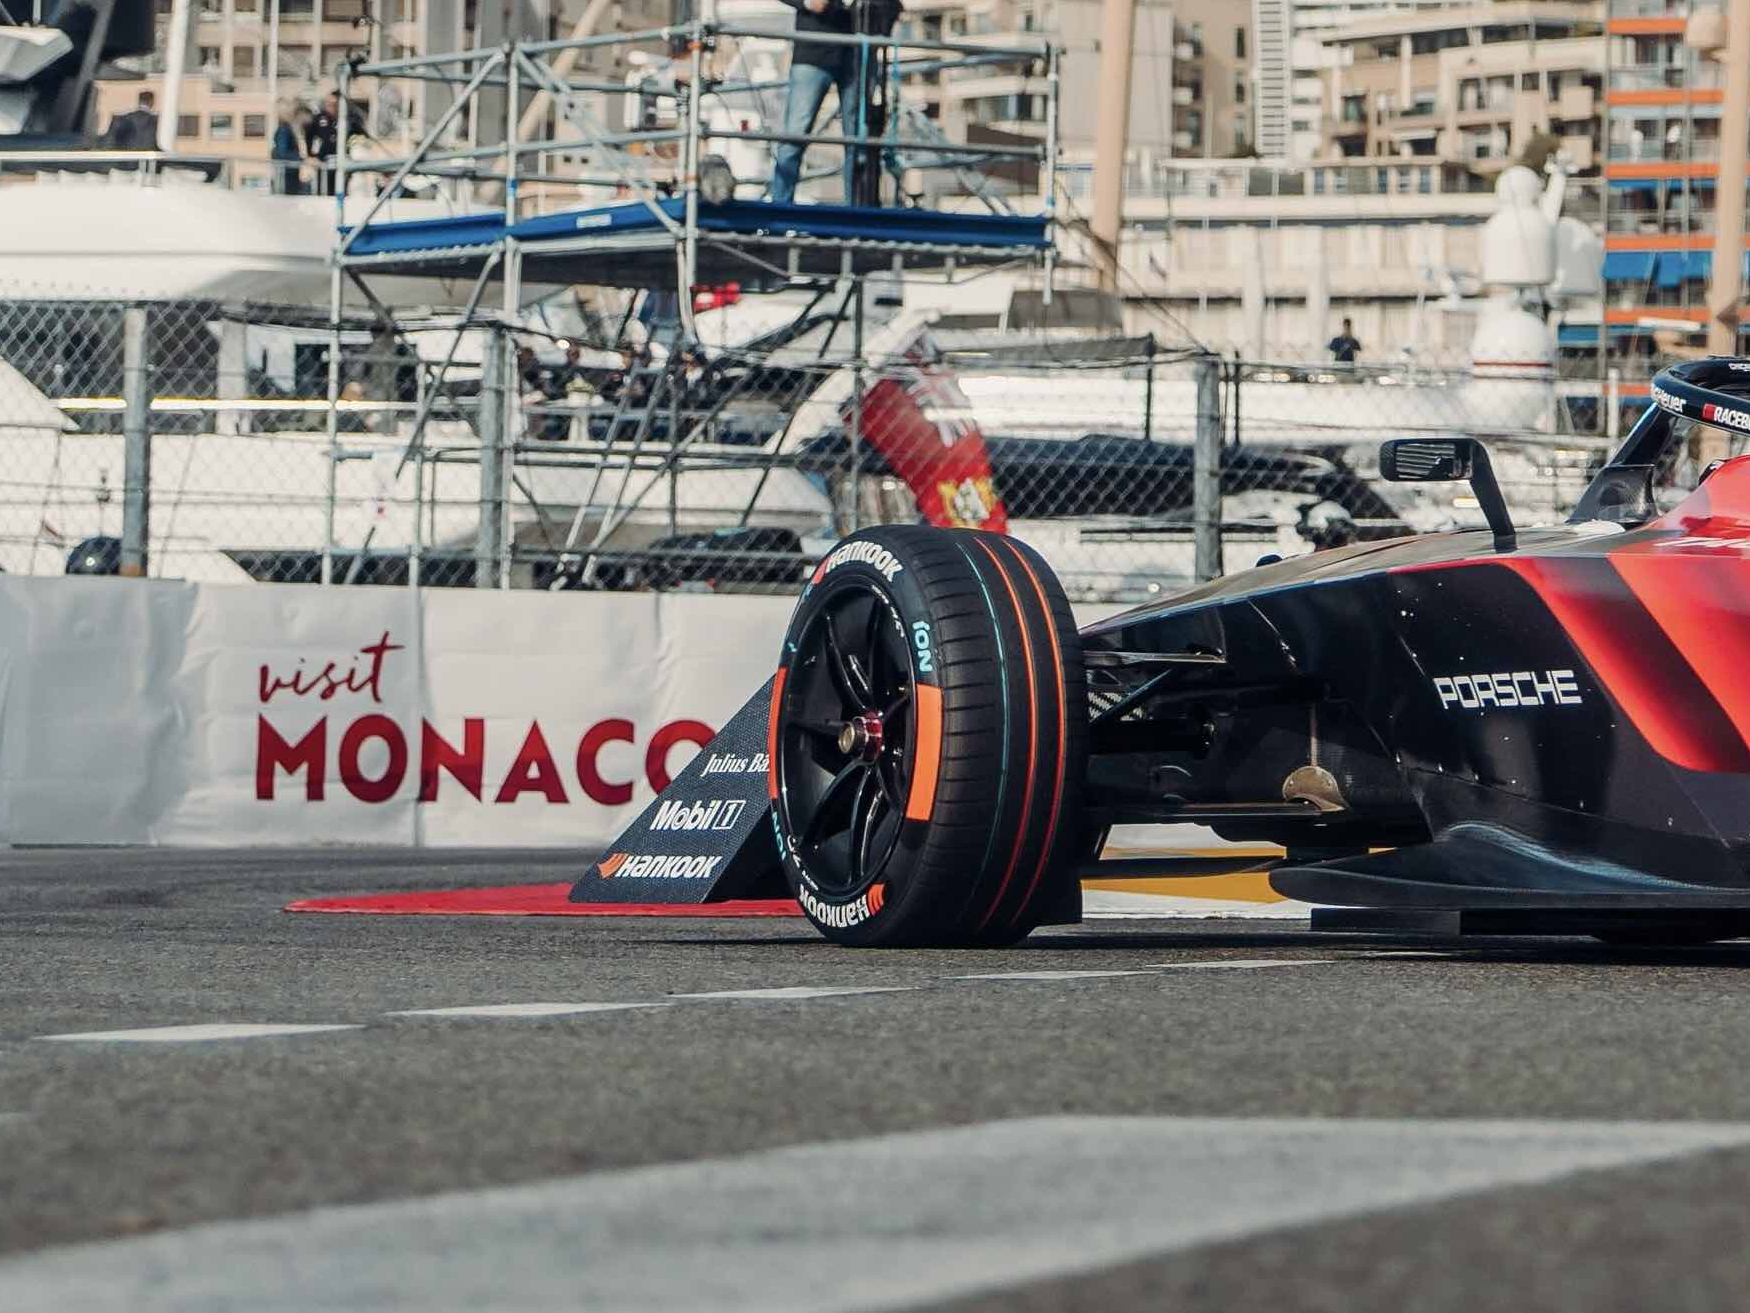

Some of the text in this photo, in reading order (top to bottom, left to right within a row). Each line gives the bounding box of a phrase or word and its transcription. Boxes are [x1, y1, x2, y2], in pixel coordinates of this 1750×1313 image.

[258, 630, 406, 704] visit
[1433, 669, 1583, 709] PORSCHE
[699, 753, 749, 777] Julius
[649, 800, 722, 830] Mobil
